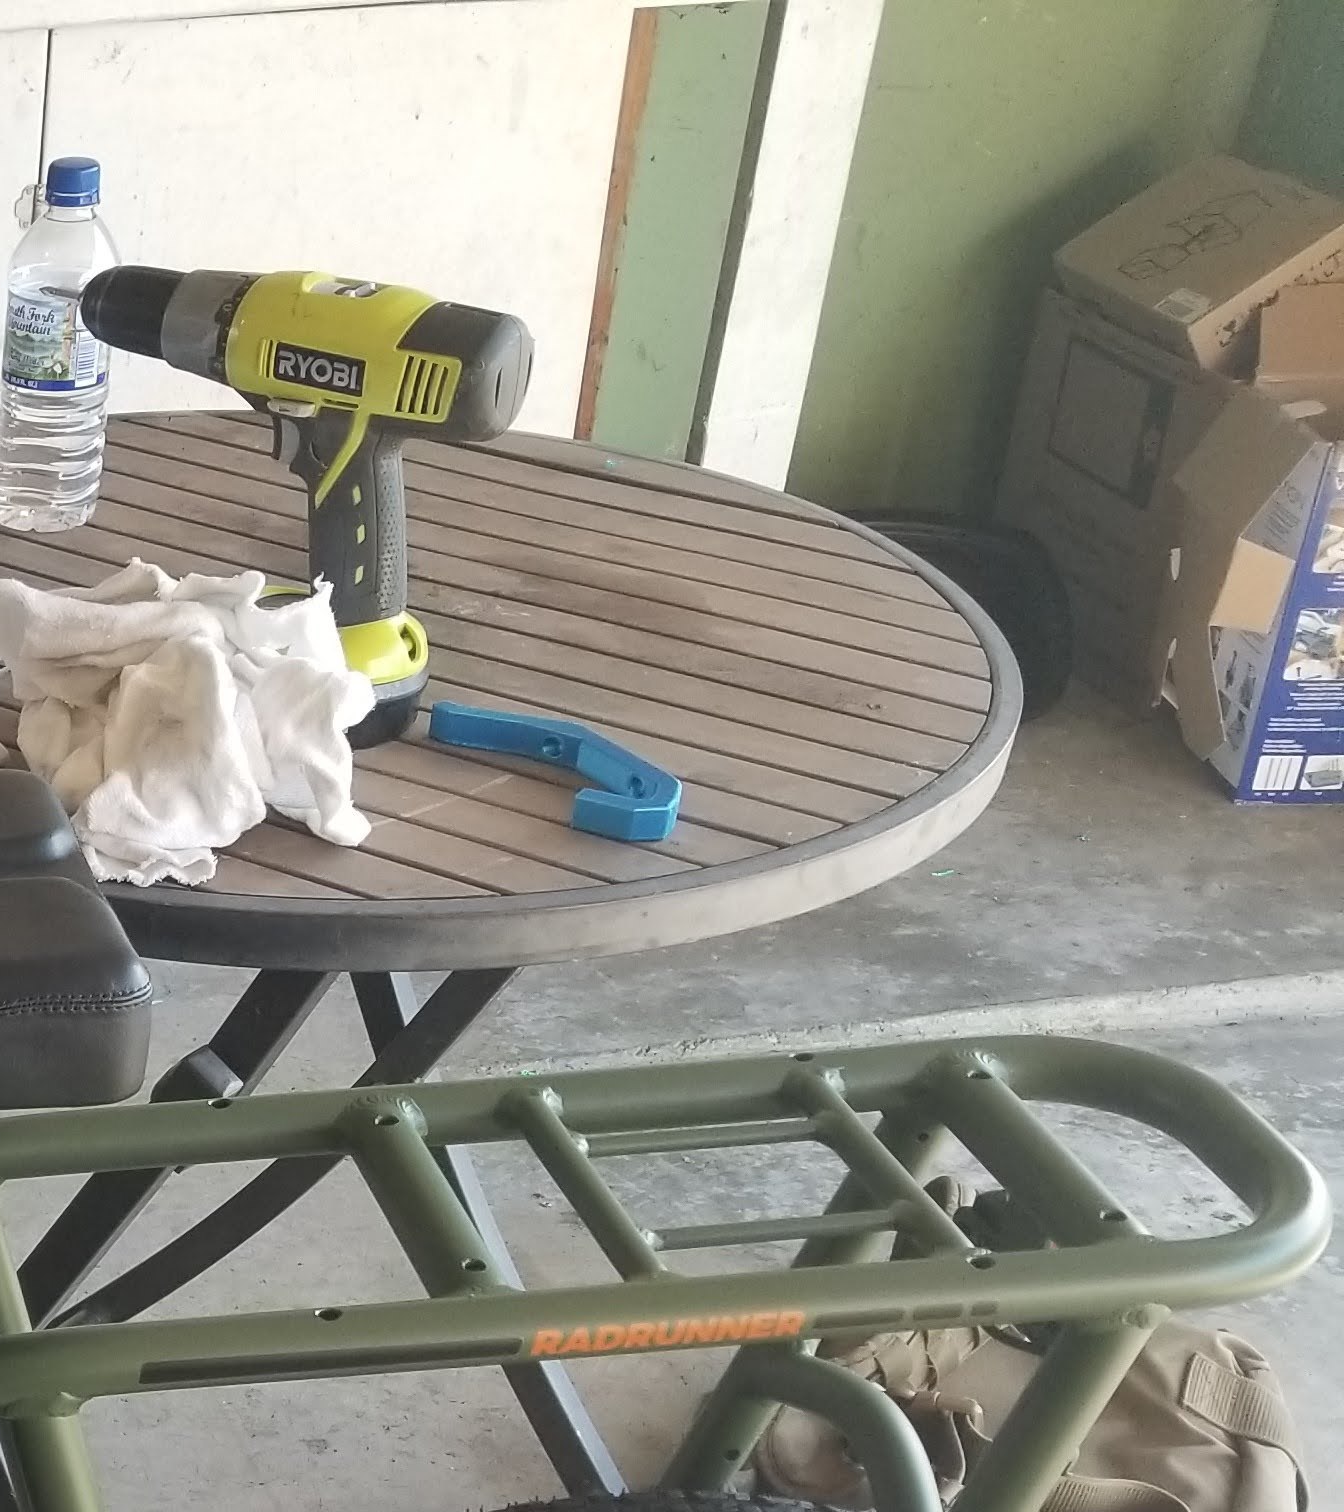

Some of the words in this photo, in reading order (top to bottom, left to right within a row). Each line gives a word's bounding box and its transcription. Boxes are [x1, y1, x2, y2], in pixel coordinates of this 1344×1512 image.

[27, 307, 55, 325] Fork
[277, 350, 360, 390] RYOBI
[530, 1310, 806, 1356] RADRUNNER
